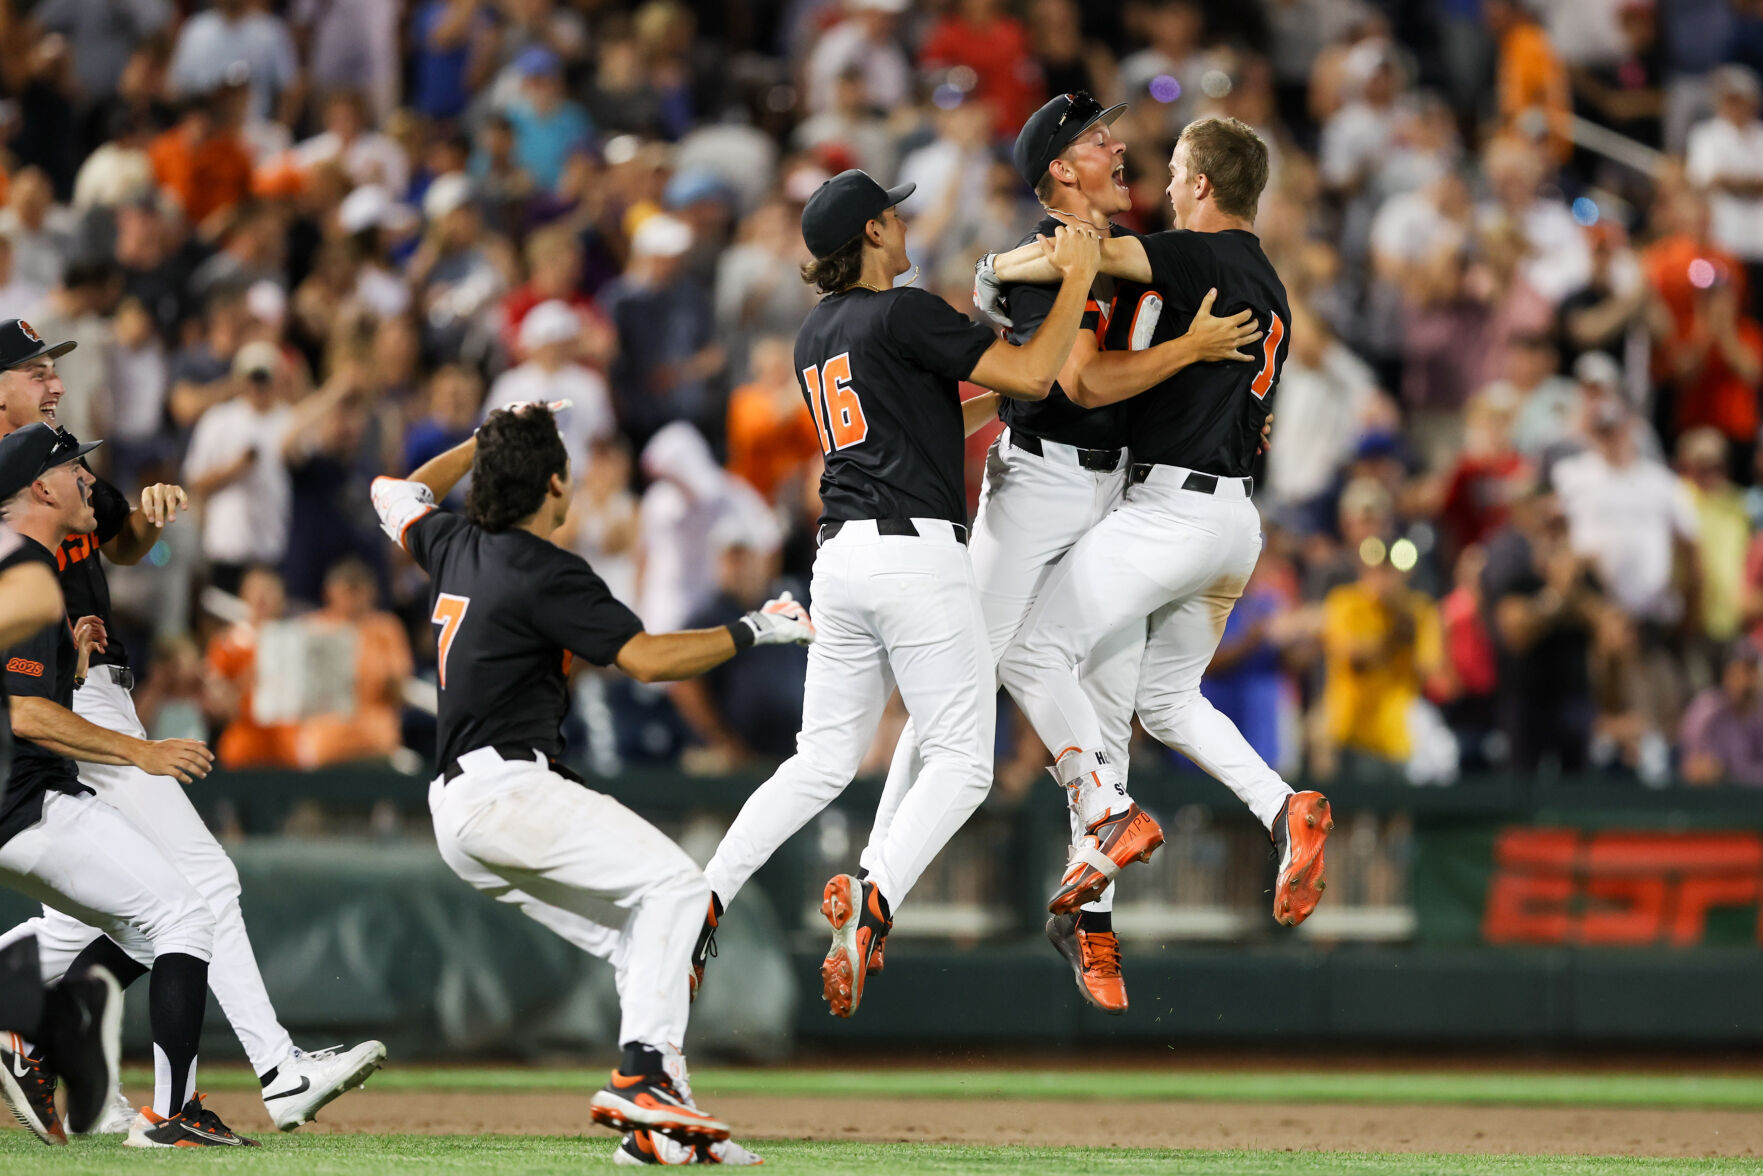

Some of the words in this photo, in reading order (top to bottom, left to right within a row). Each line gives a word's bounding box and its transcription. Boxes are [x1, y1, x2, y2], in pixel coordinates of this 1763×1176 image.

[1251, 310, 1284, 400] 1
[802, 351, 868, 456] 16
[7, 658, 44, 676] 2025
[431, 592, 471, 690] 7
[1114, 782, 1126, 796] S
[1483, 827, 1763, 945] ESP
